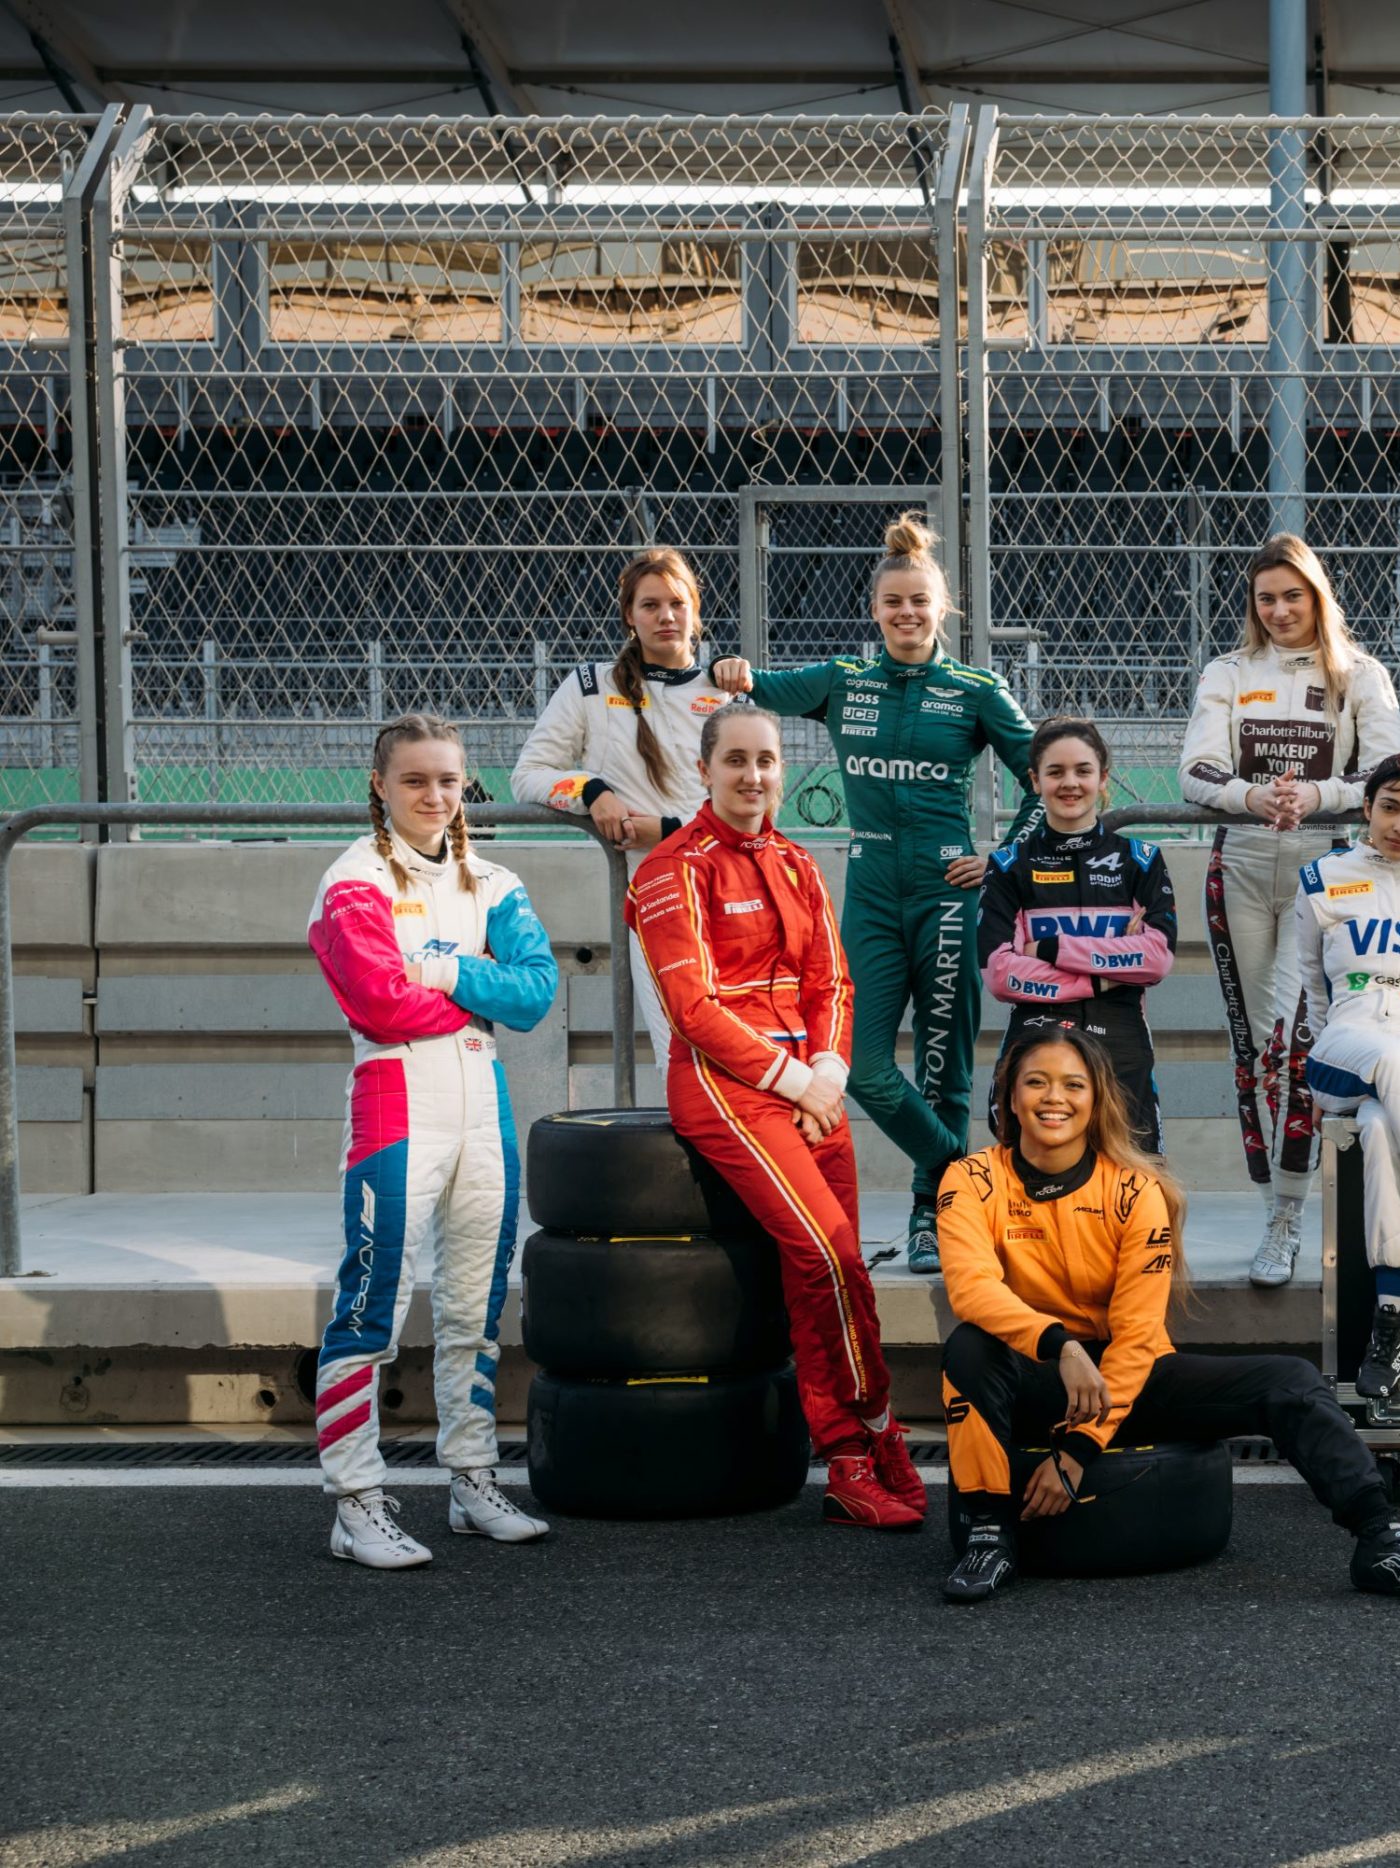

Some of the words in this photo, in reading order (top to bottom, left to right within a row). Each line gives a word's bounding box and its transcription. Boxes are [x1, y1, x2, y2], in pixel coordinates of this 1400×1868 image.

[847, 692, 879, 705] BOSS
[921, 700, 964, 713] aramco
[844, 707, 878, 721] JCB
[841, 724, 878, 737] PIRELLI
[1254, 742, 1318, 760] MAKEUP
[846, 755, 949, 780] aramco
[1267, 758, 1305, 776] YOUR
[940, 846, 963, 859] OMP
[1089, 873, 1122, 884] RODIN
[1329, 883, 1369, 897] PIRELLI
[646, 892, 680, 909] Santander
[724, 899, 764, 915] PIRELLI
[1031, 915, 1131, 941] BWT
[930, 901, 964, 1019] MARTIN
[1109, 953, 1143, 967] BWT
[1023, 981, 1059, 998] BWT
[1086, 1024, 1106, 1035] ABBI
[1007, 1228, 1044, 1240] PIRELLI
[349, 1233, 374, 1338] ACADEMY
[849, 1325, 857, 1340] AND
